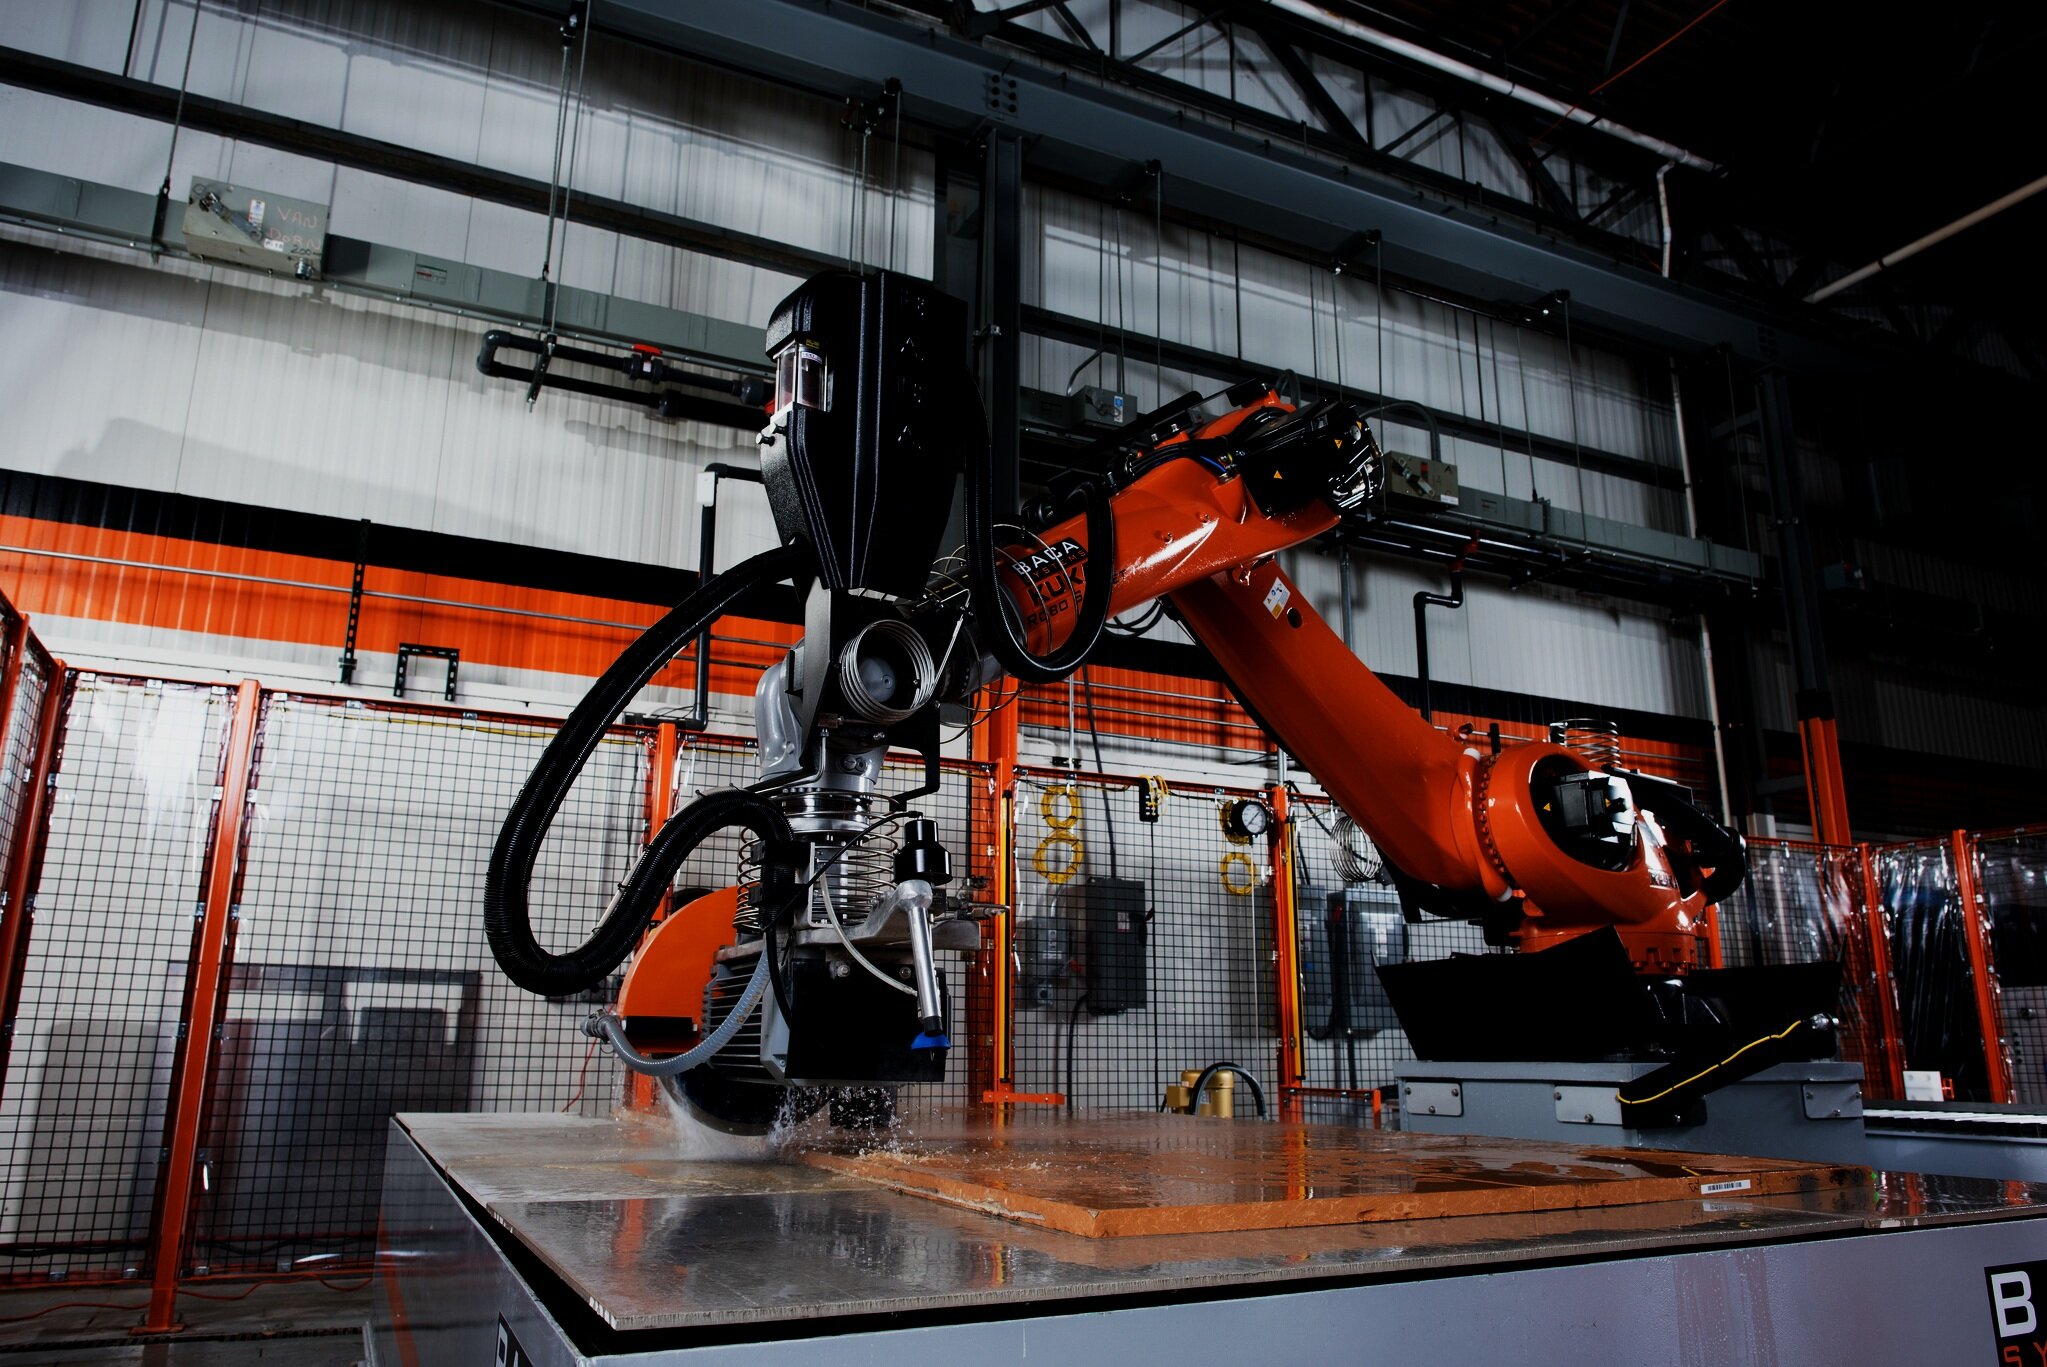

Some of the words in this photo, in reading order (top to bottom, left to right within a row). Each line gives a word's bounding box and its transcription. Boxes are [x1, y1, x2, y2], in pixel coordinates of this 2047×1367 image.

[276, 205, 318, 229] VAN
[1011, 541, 1080, 576] BACA
[1027, 561, 1088, 608] KUK
